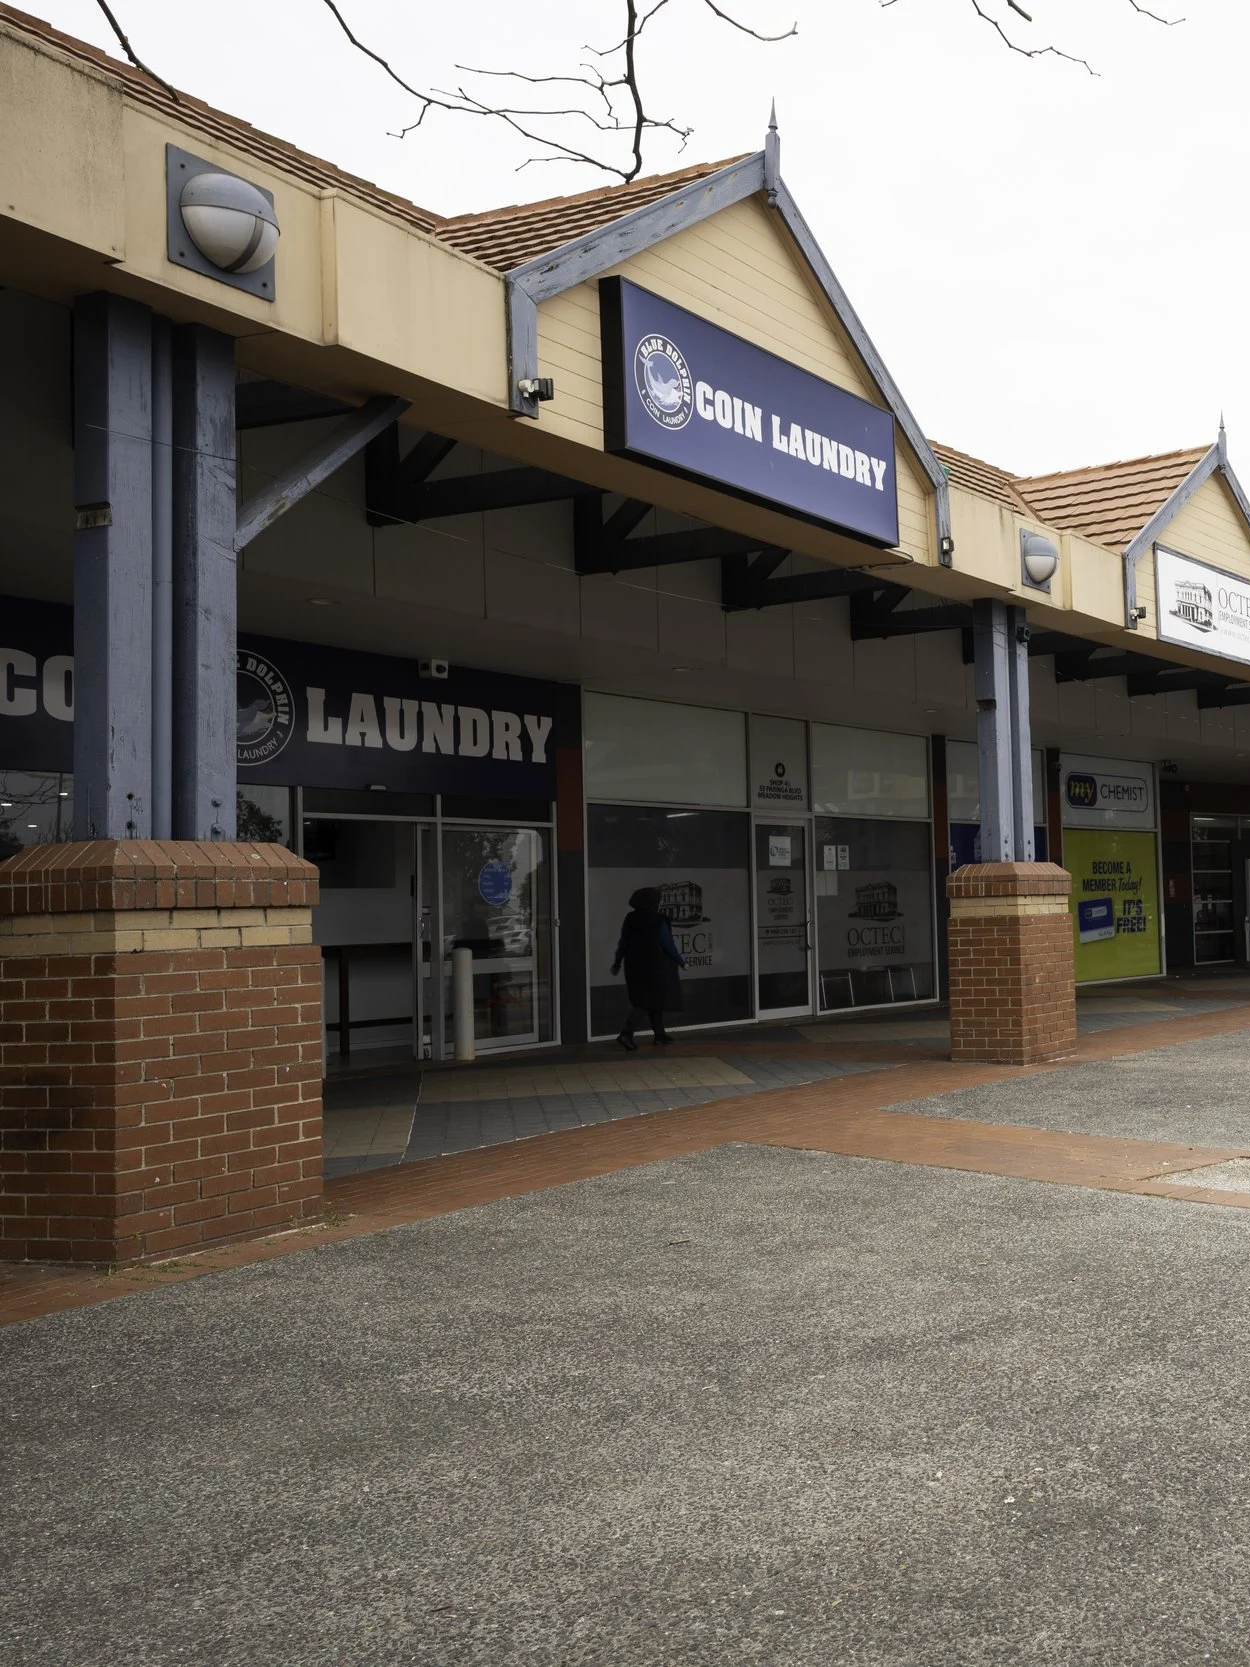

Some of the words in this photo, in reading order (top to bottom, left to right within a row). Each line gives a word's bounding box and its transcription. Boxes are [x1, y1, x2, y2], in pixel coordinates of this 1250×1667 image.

[640, 338, 664, 358] BLUE
[665, 344, 691, 404] DOLPHIN
[646, 398, 660, 418] COIN
[662, 411, 686, 425] LAUNDRY
[695, 381, 763, 444] COIN
[772, 414, 887, 491] LAUNDRY
[1219, 611, 1248, 630] EMPLOYMENT
[246, 656, 289, 726] DOLPHIN
[0, 647, 75, 723] CO
[306, 686, 553, 764] LAUNDRY
[237, 737, 274, 760] LAUNDRY
[758, 792, 782, 800] MEADOW
[782, 794, 804, 802] HEIGHTS
[1069, 780, 1095, 804] my
[1100, 784, 1144, 801] CHEMIST
[1092, 861, 1126, 875] BECOME
[1126, 861, 1132, 874] A
[1082, 878, 1117, 893] MEMBER
[1117, 876, 1143, 896] Today!
[1122, 899, 1143, 916] IT'S
[1116, 916, 1146, 934] FREE!
[847, 926, 901, 947] OCTEC
[685, 955, 713, 967] SERVICE
